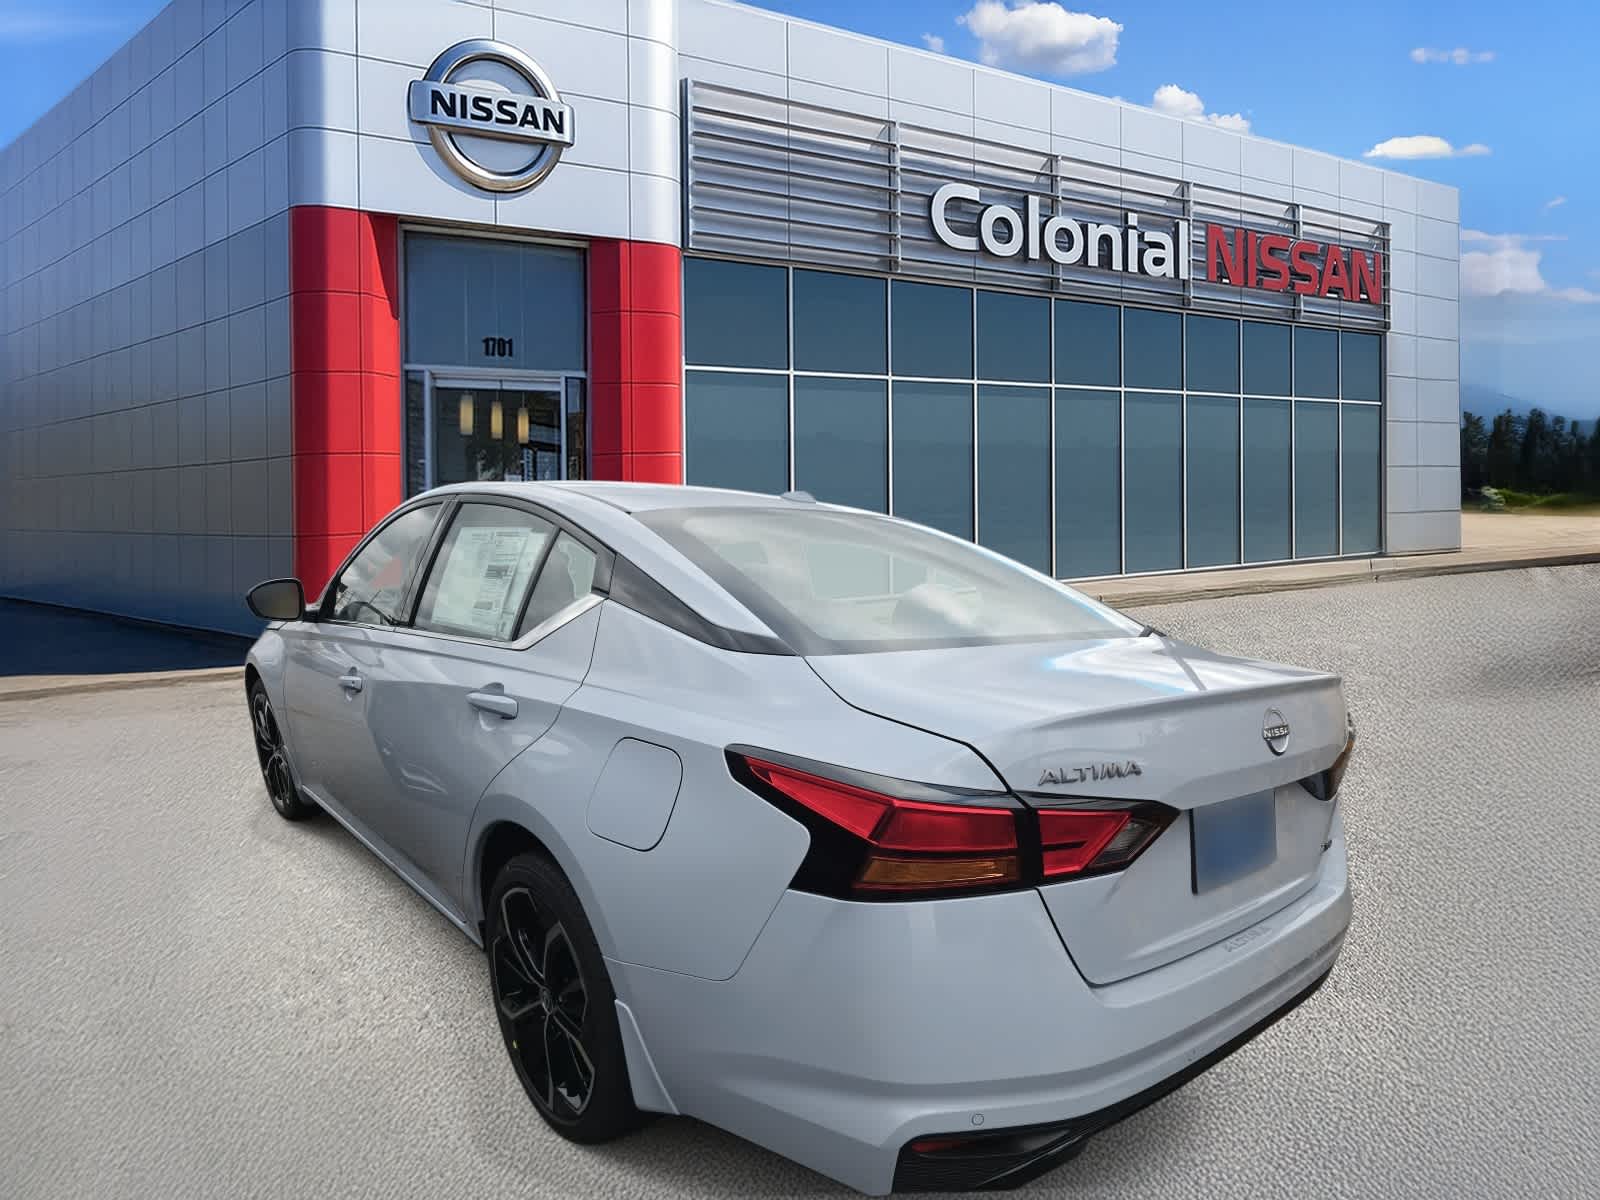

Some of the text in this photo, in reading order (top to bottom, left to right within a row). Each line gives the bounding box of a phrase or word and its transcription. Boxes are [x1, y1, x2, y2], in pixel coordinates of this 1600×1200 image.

[430, 90, 564, 134] NISSAN
[930, 182, 1382, 304] Colonial NISSAN
[482, 337, 513, 357] 1701
[1038, 761, 1142, 786] ALTIMA
